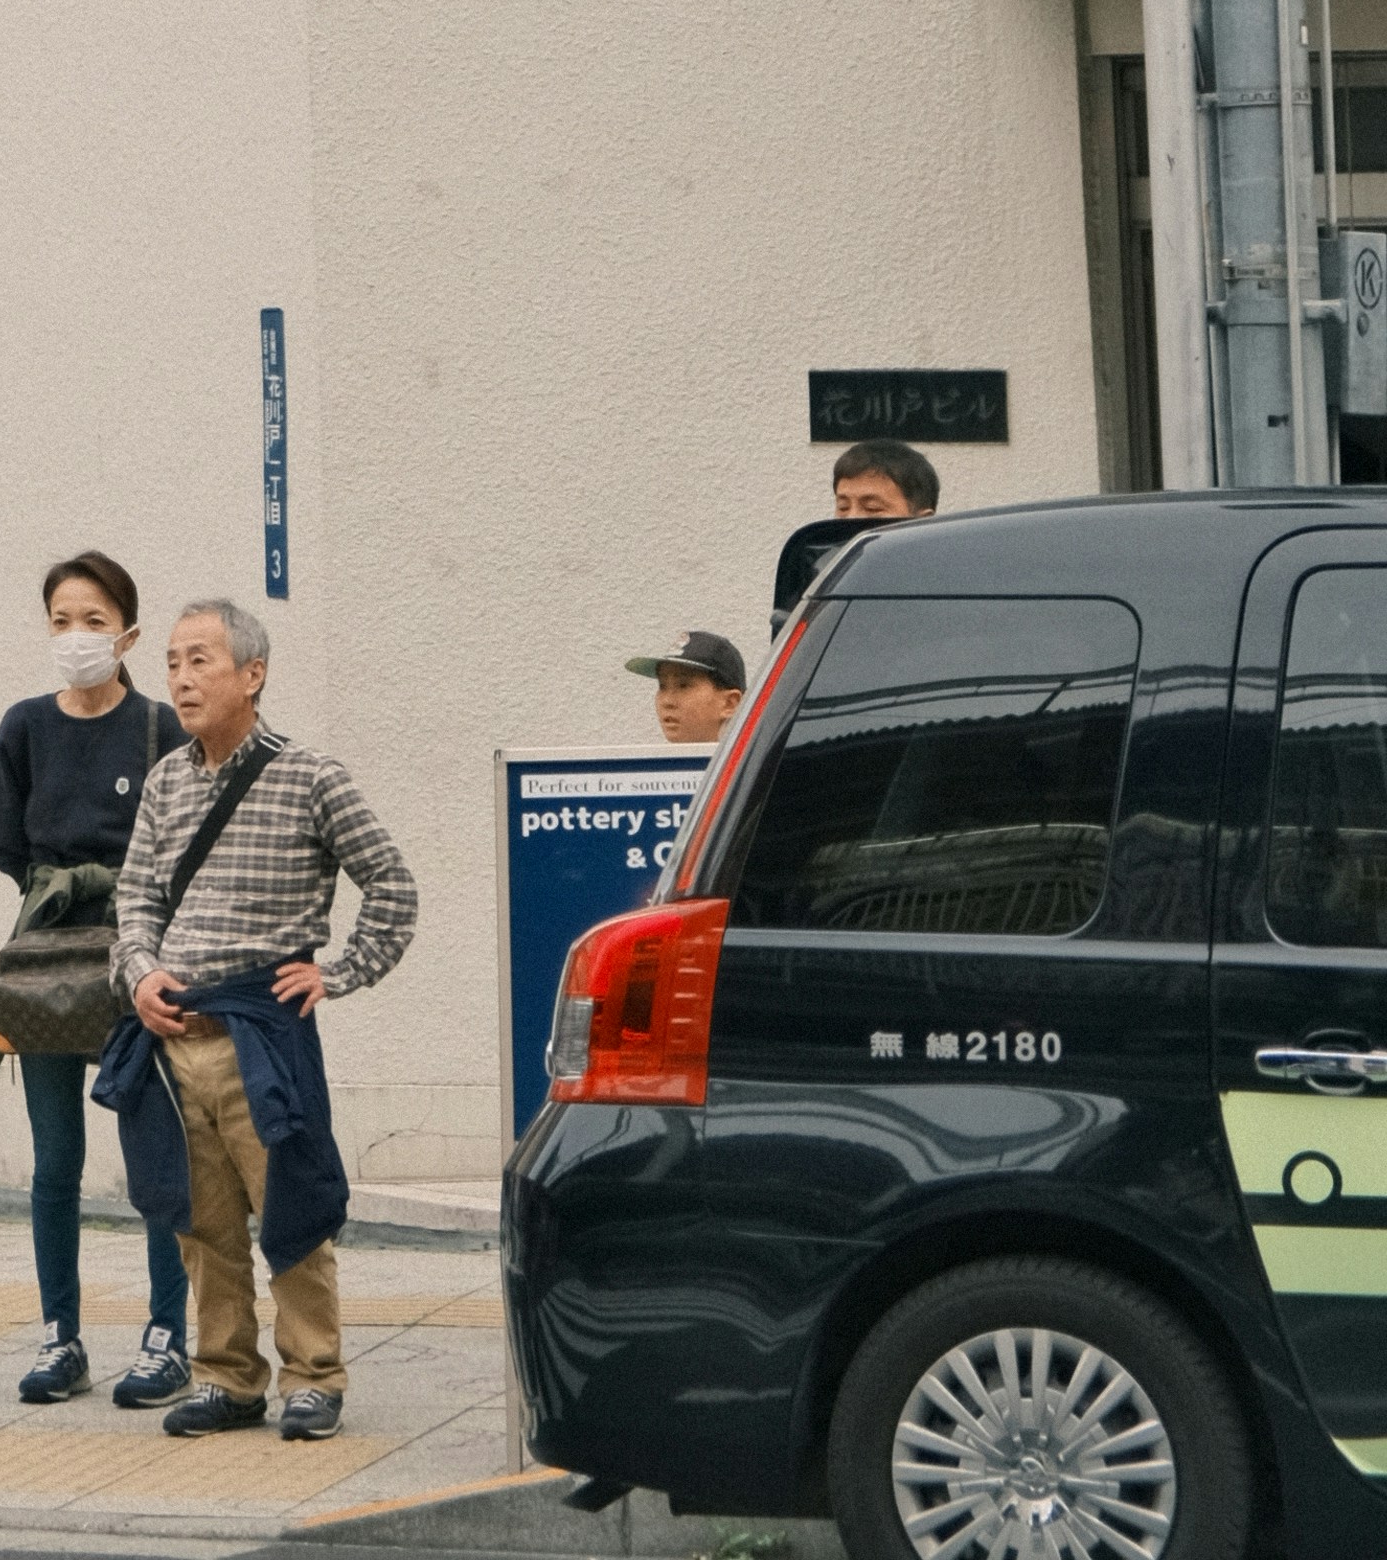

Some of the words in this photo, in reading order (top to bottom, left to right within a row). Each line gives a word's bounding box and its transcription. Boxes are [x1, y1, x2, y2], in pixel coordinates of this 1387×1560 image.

[1360, 260, 1376, 298] K
[816, 387, 997, 426] 花川戸ビル
[272, 549, 282, 579] 3
[528, 779, 588, 794] Perfect
[598, 777, 623, 793] for
[631, 776, 698, 792] souveni
[522, 806, 646, 837] pottery
[655, 803, 688, 829] sh
[626, 847, 648, 869] &
